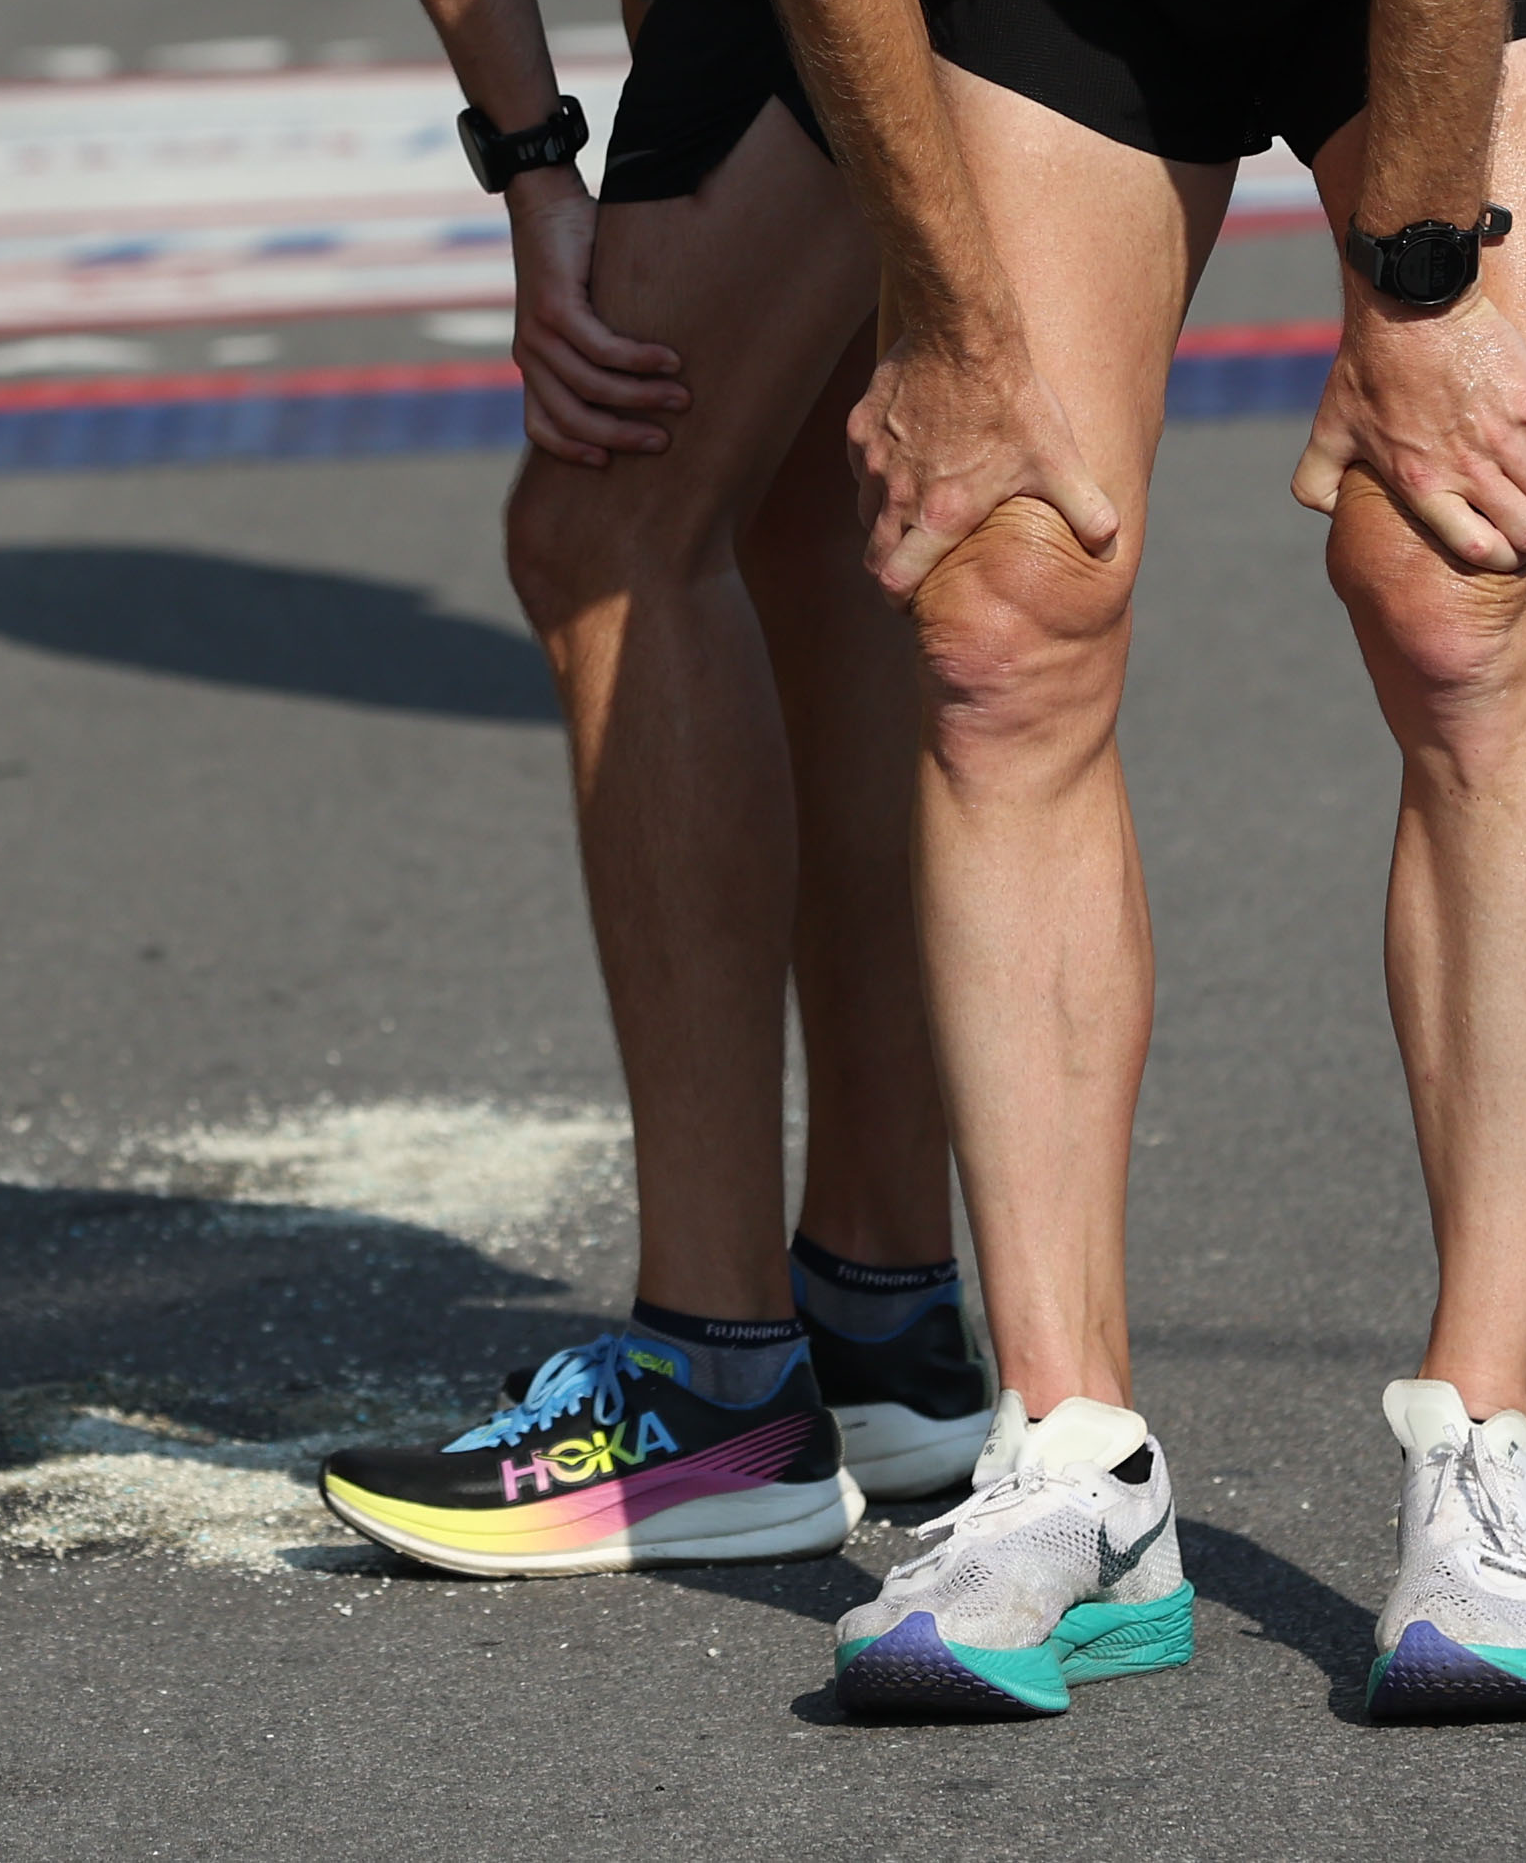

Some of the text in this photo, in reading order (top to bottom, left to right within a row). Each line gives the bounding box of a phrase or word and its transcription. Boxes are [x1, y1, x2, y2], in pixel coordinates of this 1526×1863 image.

[705, 1321, 792, 1339] RUNNING
[627, 1348, 676, 1378] HOKA
[499, 1411, 680, 1504] HOKA
